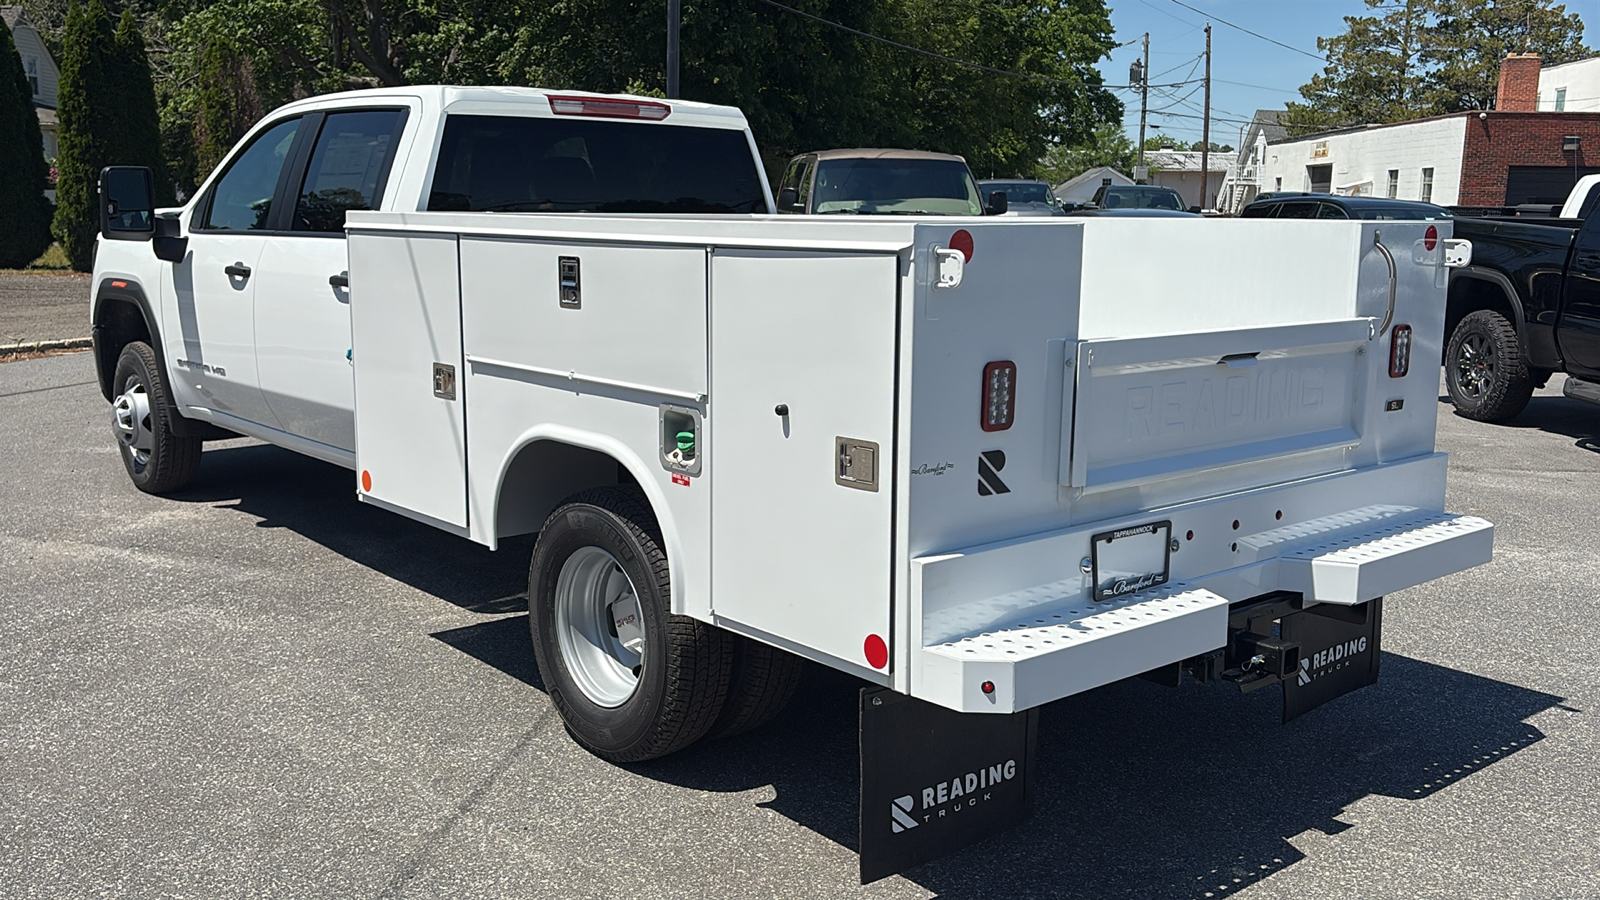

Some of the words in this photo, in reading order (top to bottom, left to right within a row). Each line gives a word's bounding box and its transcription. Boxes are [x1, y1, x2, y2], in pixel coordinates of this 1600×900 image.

[1122, 367, 1325, 443] READING
[1391, 401, 1399, 410] SL
[1113, 525, 1154, 538] TAPPAHANNOCK
[1113, 573, 1155, 595] Bareford
[1313, 636, 1367, 670] READING
[1313, 661, 1350, 680] TRUCK
[922, 759, 1016, 810] READING
[923, 793, 991, 822] TRUCK
